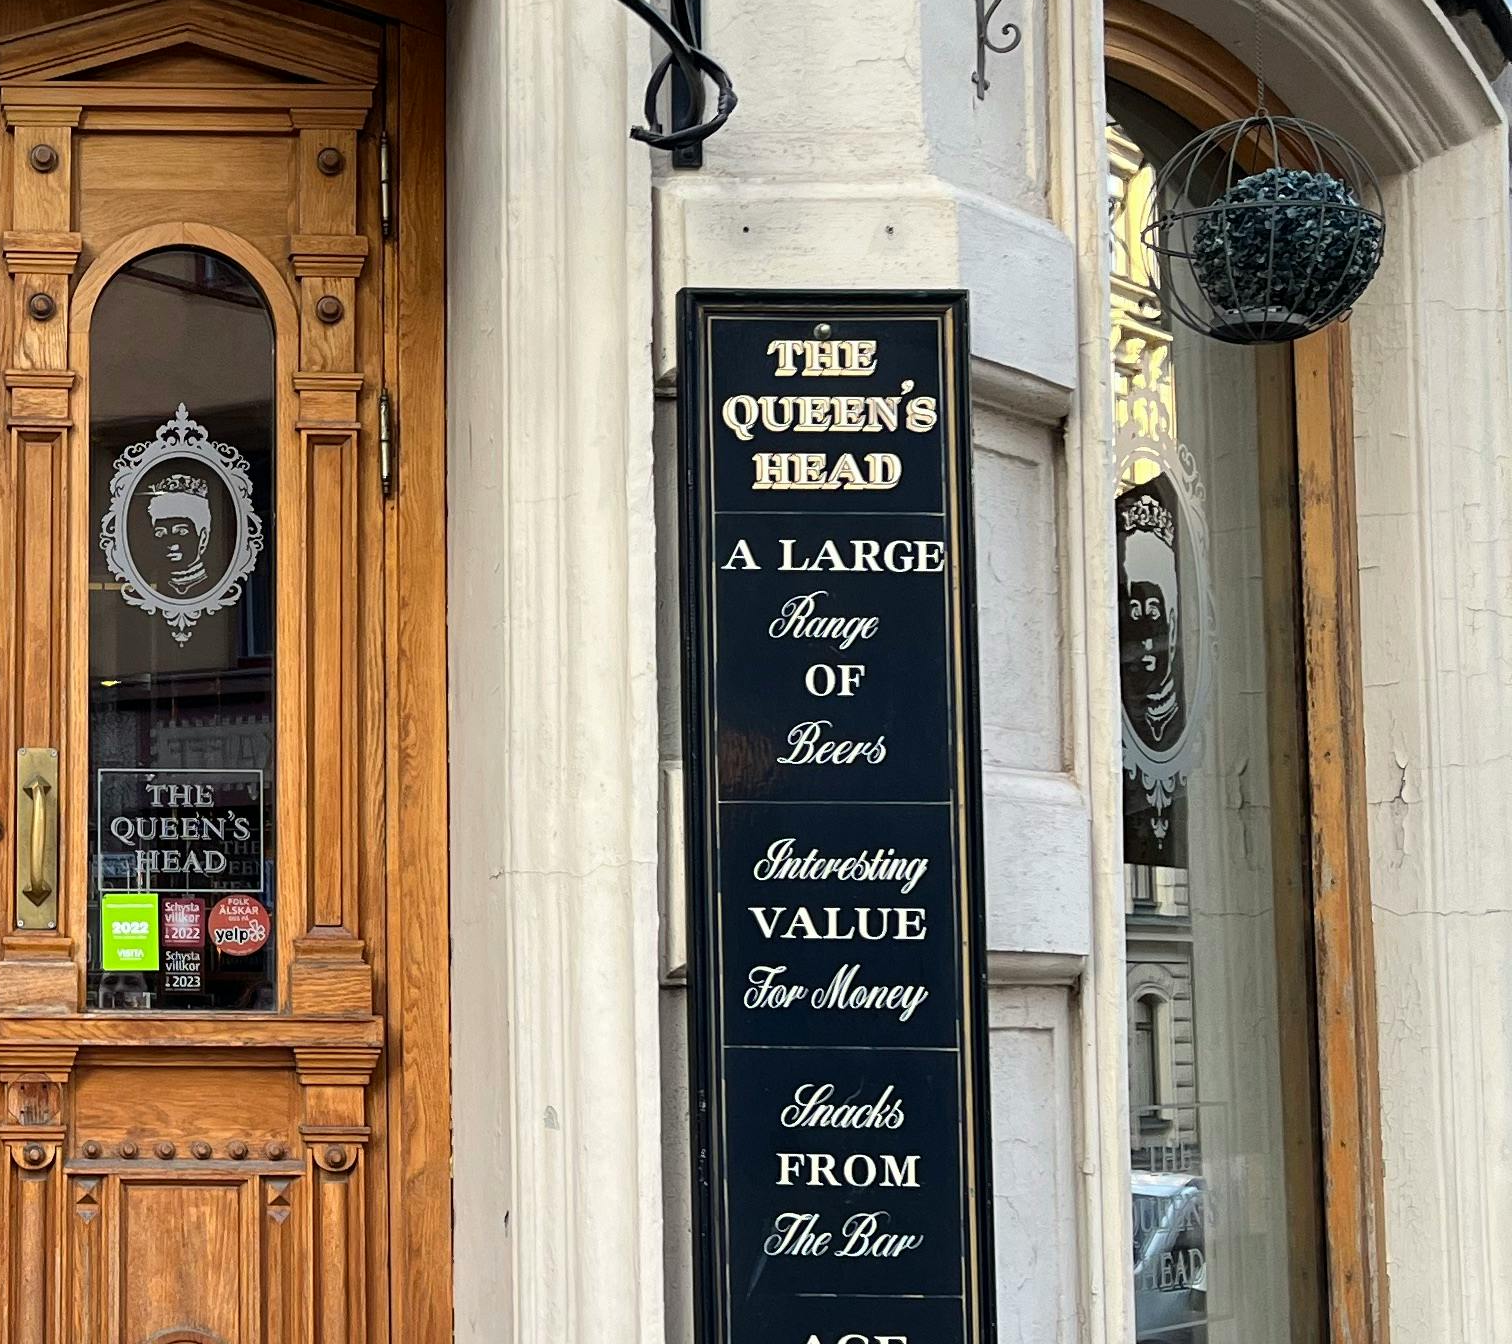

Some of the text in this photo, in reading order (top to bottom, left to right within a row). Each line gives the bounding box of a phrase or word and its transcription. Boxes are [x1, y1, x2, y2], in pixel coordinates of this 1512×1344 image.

[766, 338, 878, 378] THE
[720, 378, 939, 442] QUEEN'S
[751, 451, 904, 492] HEAD
[720, 539, 946, 574] A LARGE
[768, 589, 881, 654] Range
[804, 663, 867, 698] OF
[776, 719, 888, 766] Beers
[146, 783, 215, 808] THE
[110, 809, 251, 846] QUEEN'S
[134, 849, 228, 875] HEAD
[753, 837, 928, 895] Interesting
[164, 901, 200, 917] Schysta
[164, 911, 201, 924] villkor
[219, 904, 259, 915] ÄLSKAR
[228, 898, 250, 906] FOLK
[171, 926, 201, 940] 2022
[215, 927, 249, 945] yelp
[746, 907, 927, 941] VALUE
[165, 950, 201, 966] Schysta
[165, 960, 201, 972] villkor
[172, 975, 201, 988] 2023
[743, 963, 929, 1023] For Money
[780, 1082, 906, 1130] Snacks
[775, 1152, 921, 1189] FROM
[763, 1210, 925, 1258] The Bar
